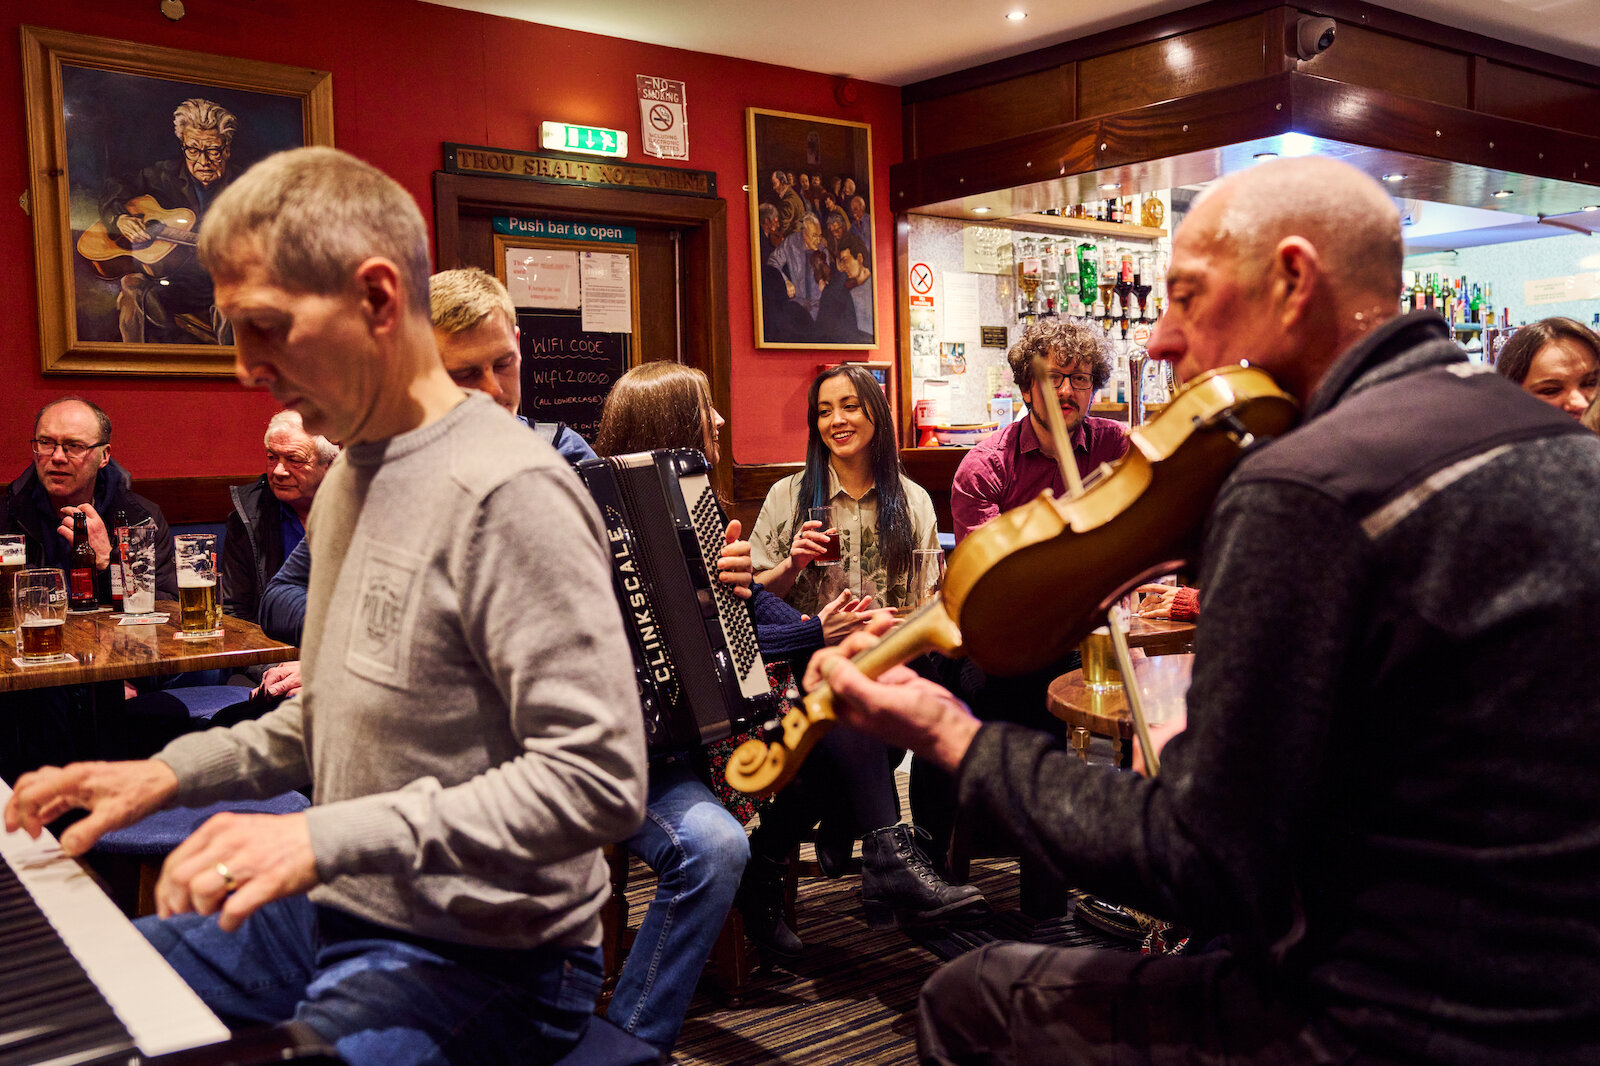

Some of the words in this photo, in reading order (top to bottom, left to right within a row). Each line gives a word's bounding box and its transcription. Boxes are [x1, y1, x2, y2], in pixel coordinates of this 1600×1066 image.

[642, 88, 680, 103] SMOKING
[457, 151, 515, 171] THOU
[524, 158, 591, 181] SHALT
[600, 165, 636, 185] NOT
[509, 217, 545, 234] Push
[548, 220, 570, 235] bar
[573, 222, 587, 236] to
[590, 225, 623, 240] open
[532, 337, 564, 353] WIFI
[569, 339, 605, 354] CODE
[608, 526, 671, 683] CLINKSCALE
